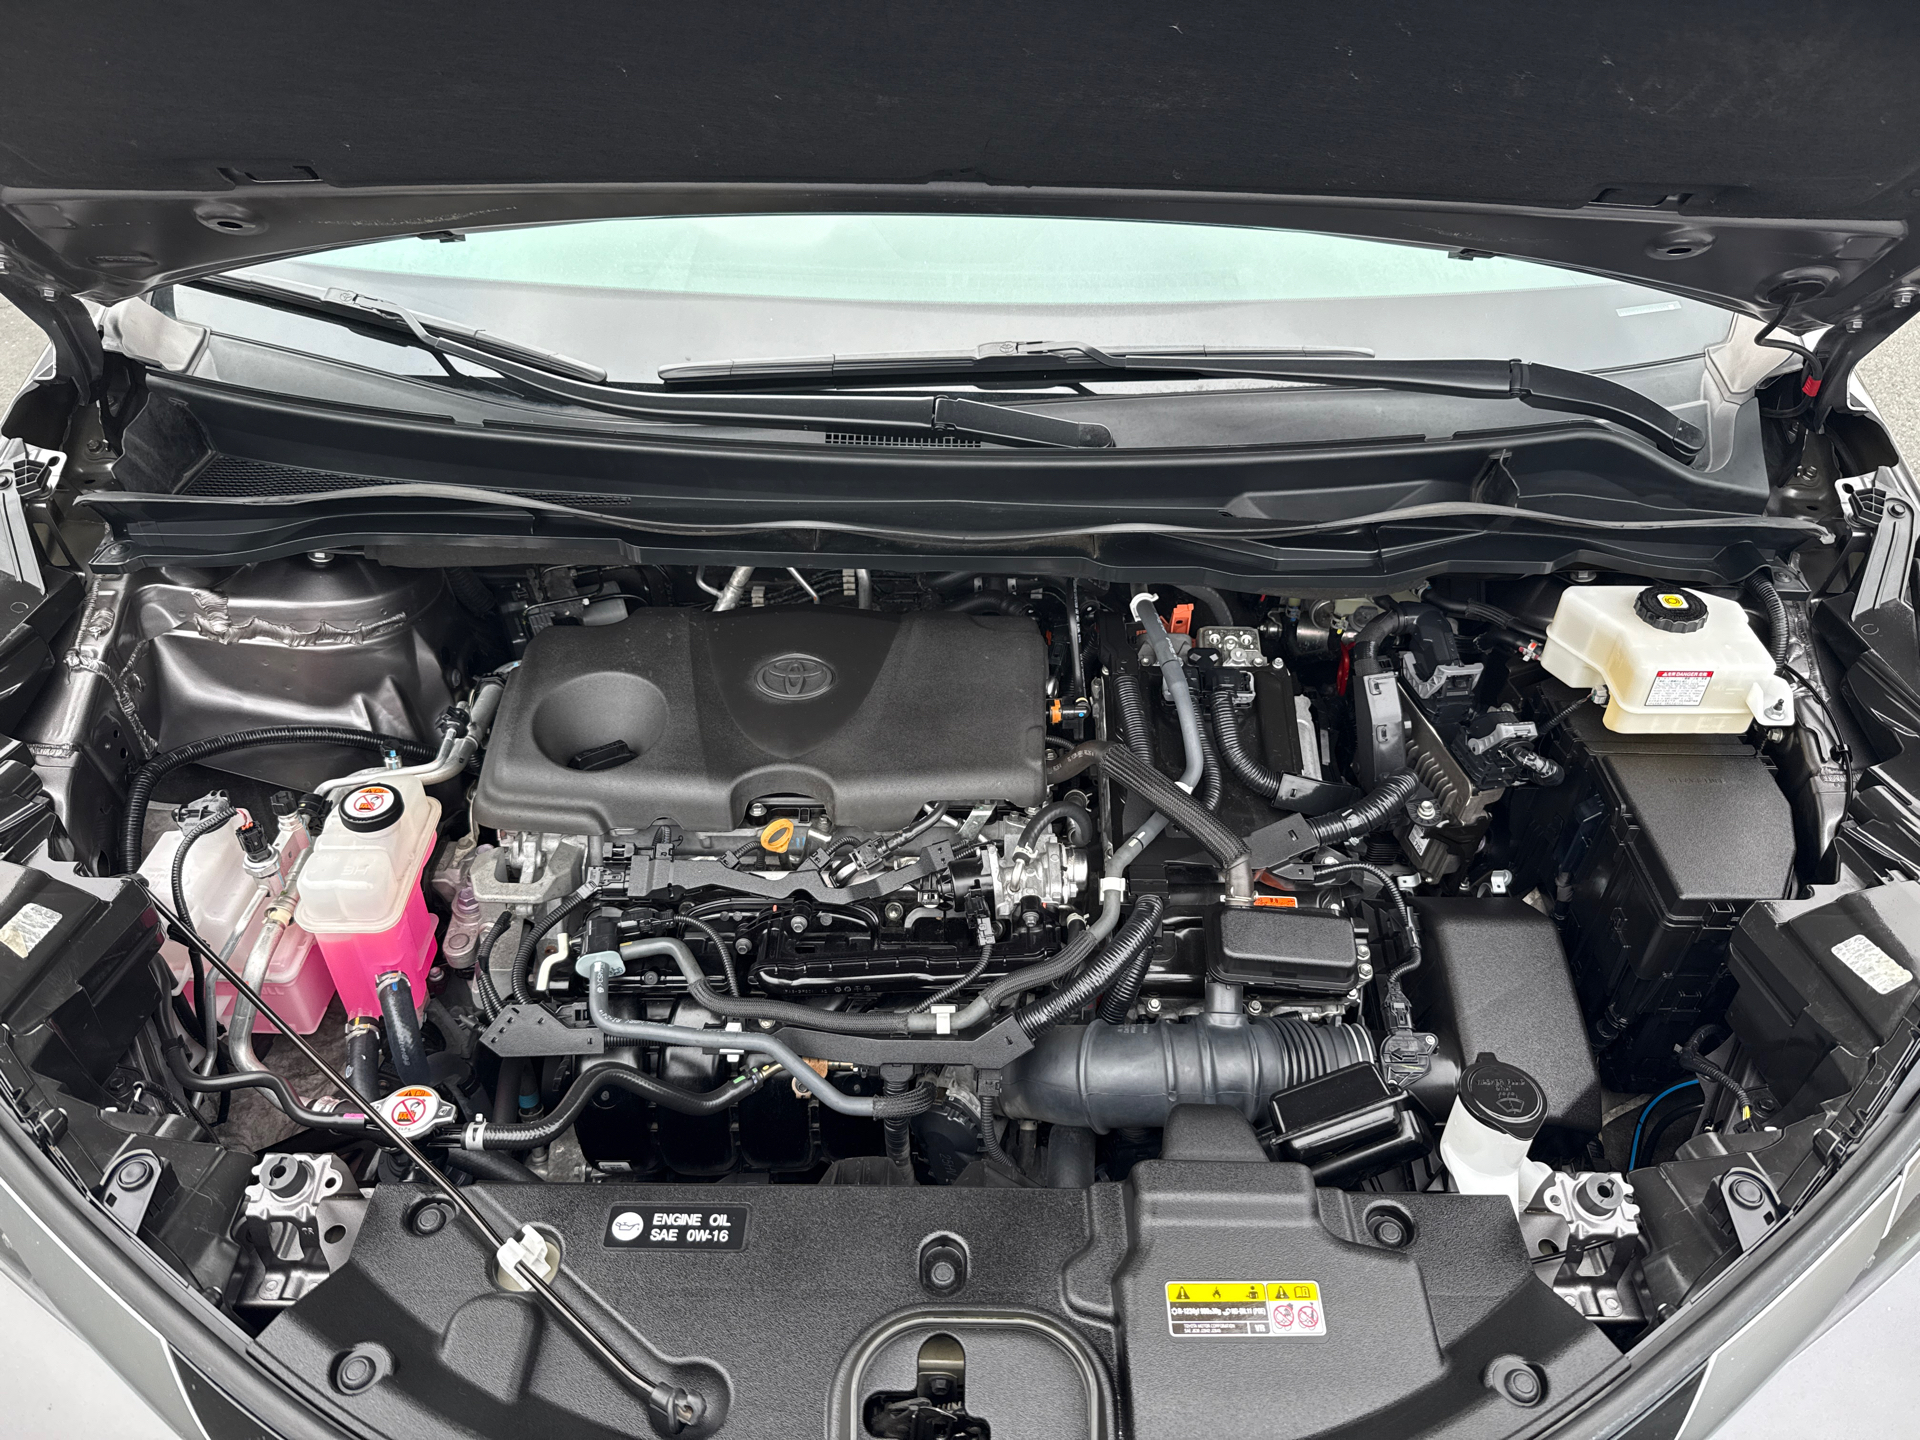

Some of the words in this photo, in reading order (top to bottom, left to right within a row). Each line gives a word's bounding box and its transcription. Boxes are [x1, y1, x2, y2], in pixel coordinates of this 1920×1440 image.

[653, 1213, 702, 1226] ENGINE
[709, 1214, 731, 1227] OIL
[649, 1228, 678, 1241] SAE
[686, 1229, 729, 1242] 0W-16
[1254, 1324, 1266, 1332] VR
